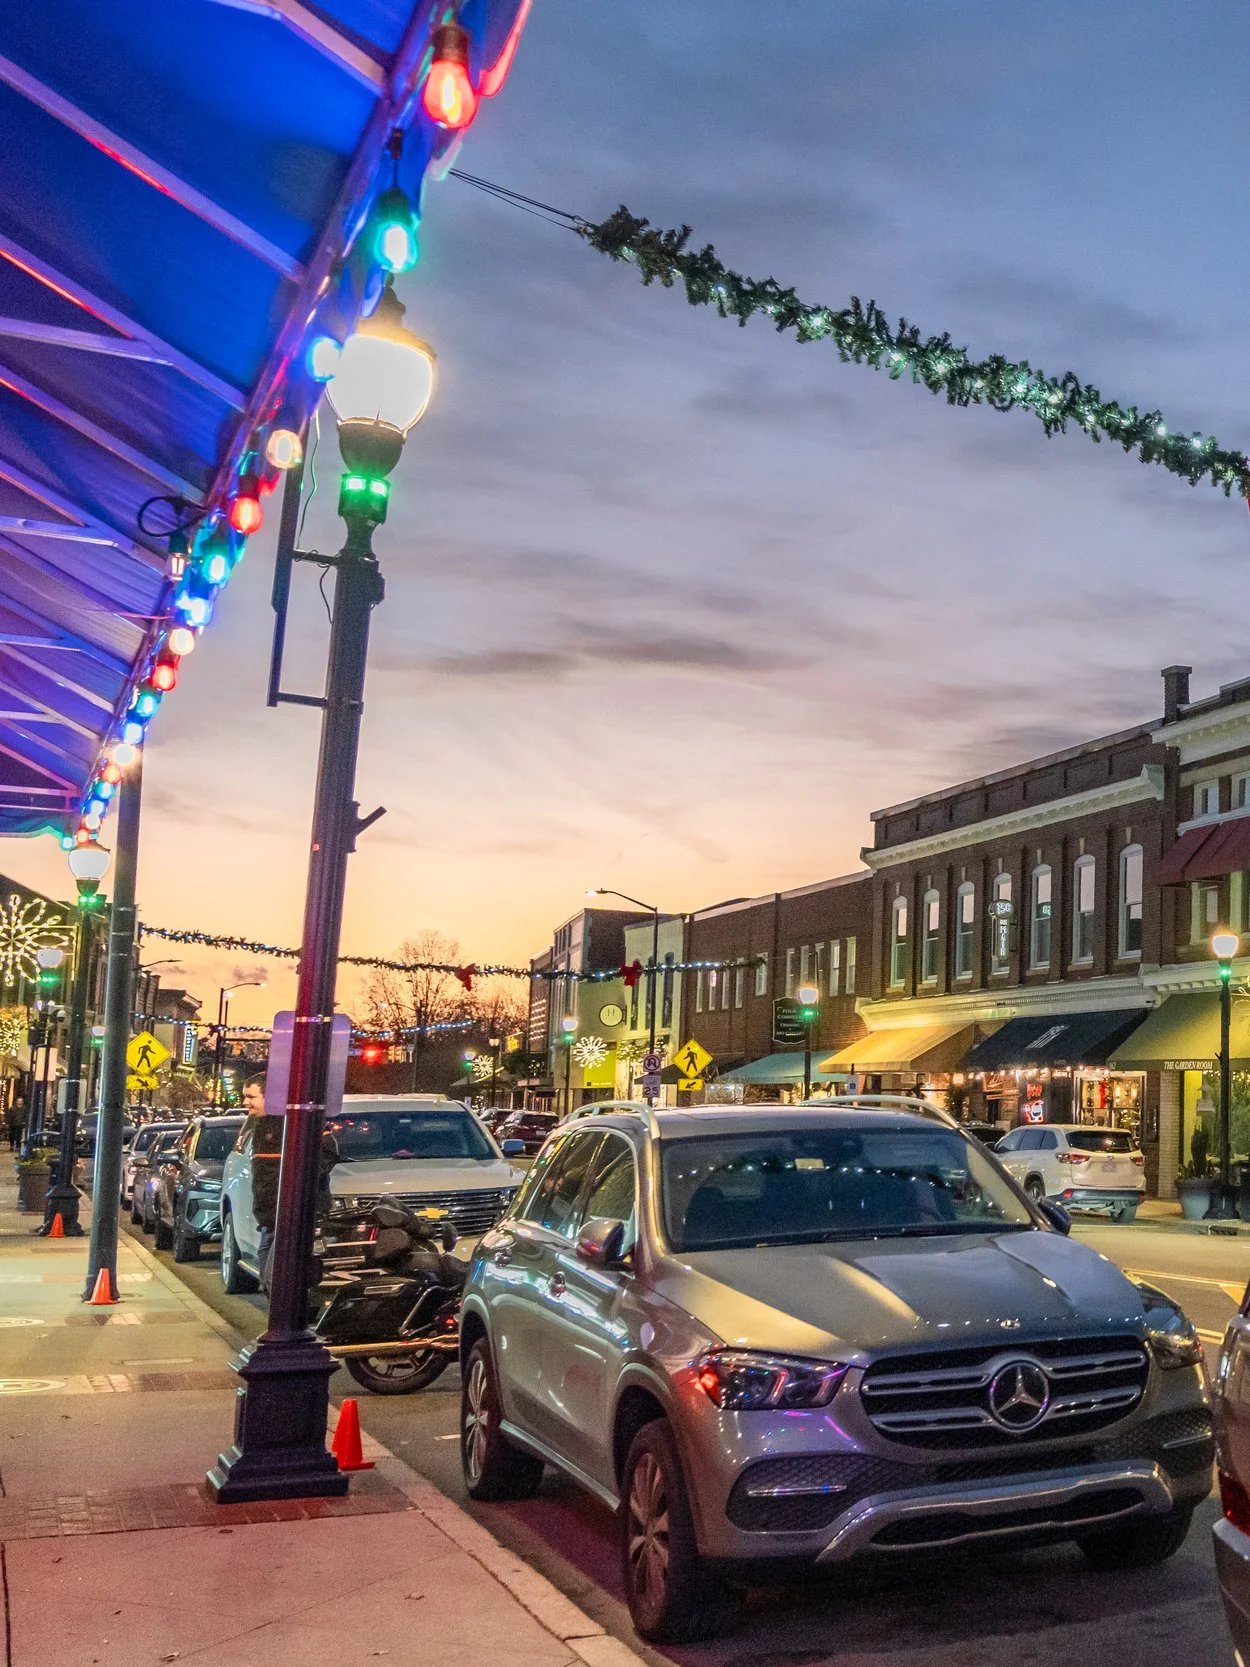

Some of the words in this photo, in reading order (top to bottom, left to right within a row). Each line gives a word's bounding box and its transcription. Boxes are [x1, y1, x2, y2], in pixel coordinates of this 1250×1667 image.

[1164, 1061, 1175, 1070] THE
[1175, 1061, 1197, 1070] GARDEN
[1196, 1061, 1213, 1070] ROOM
[644, 1086, 659, 1096] 25
